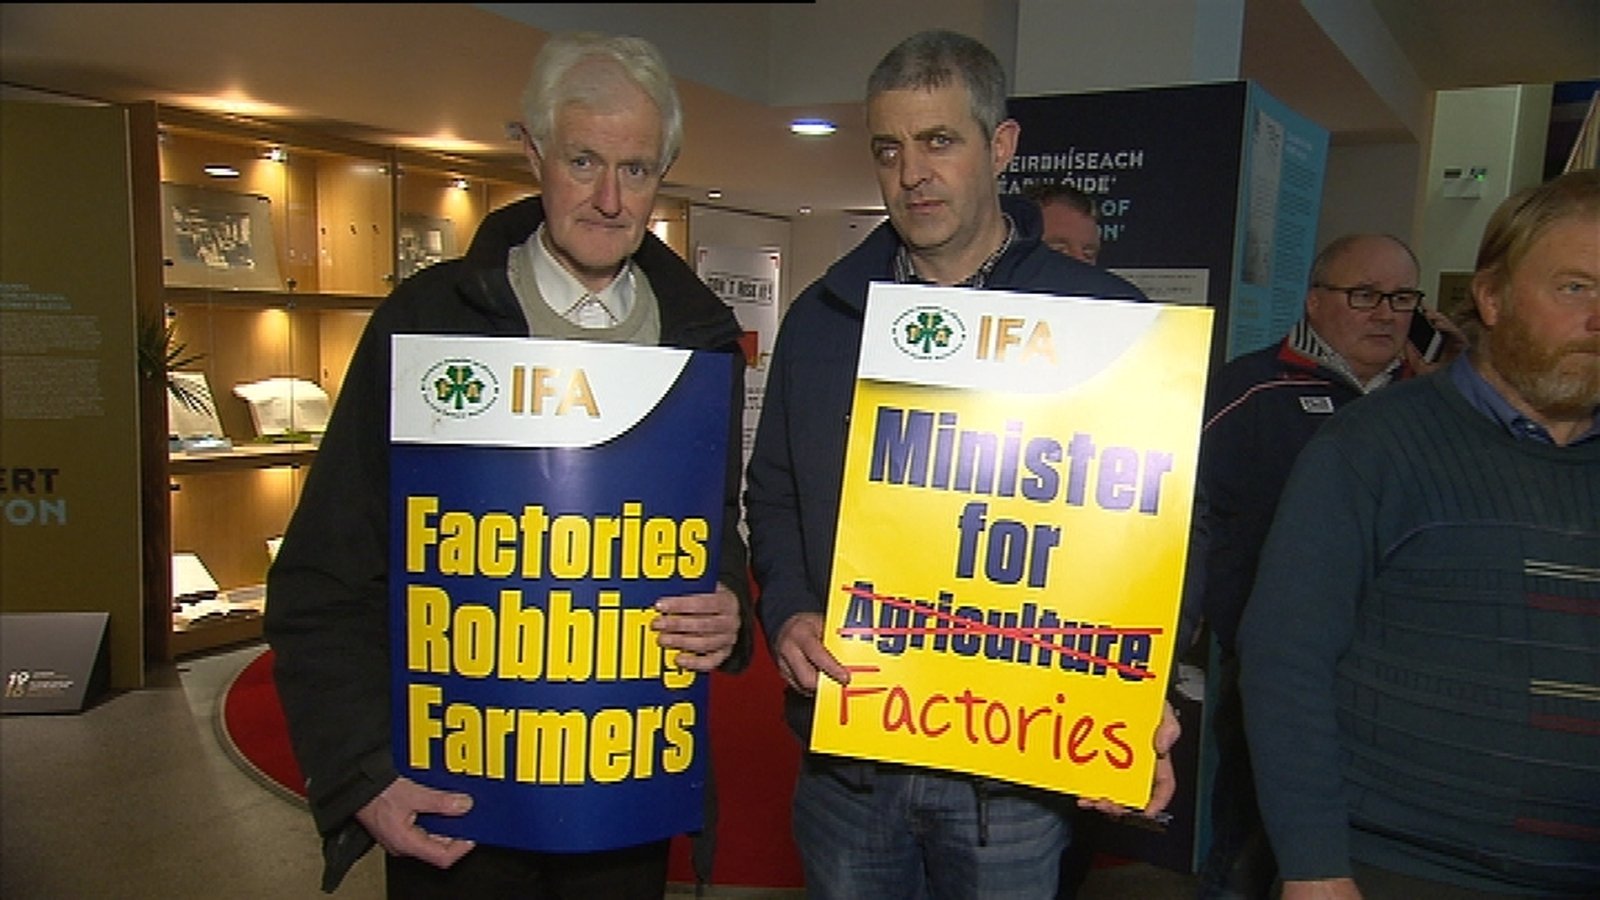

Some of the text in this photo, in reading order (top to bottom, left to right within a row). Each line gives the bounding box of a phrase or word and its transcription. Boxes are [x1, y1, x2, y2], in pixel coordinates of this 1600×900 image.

[1101, 200, 1131, 216] OF
[975, 315, 1059, 366] IFA
[510, 365, 600, 416] IFA
[869, 406, 1173, 515] Minister
[0, 498, 67, 526] ON
[406, 496, 709, 579] Factories
[956, 502, 1061, 588] for
[841, 581, 1151, 681] Agriculture
[408, 684, 696, 784] Farmers
[839, 665, 1134, 769] Factories
